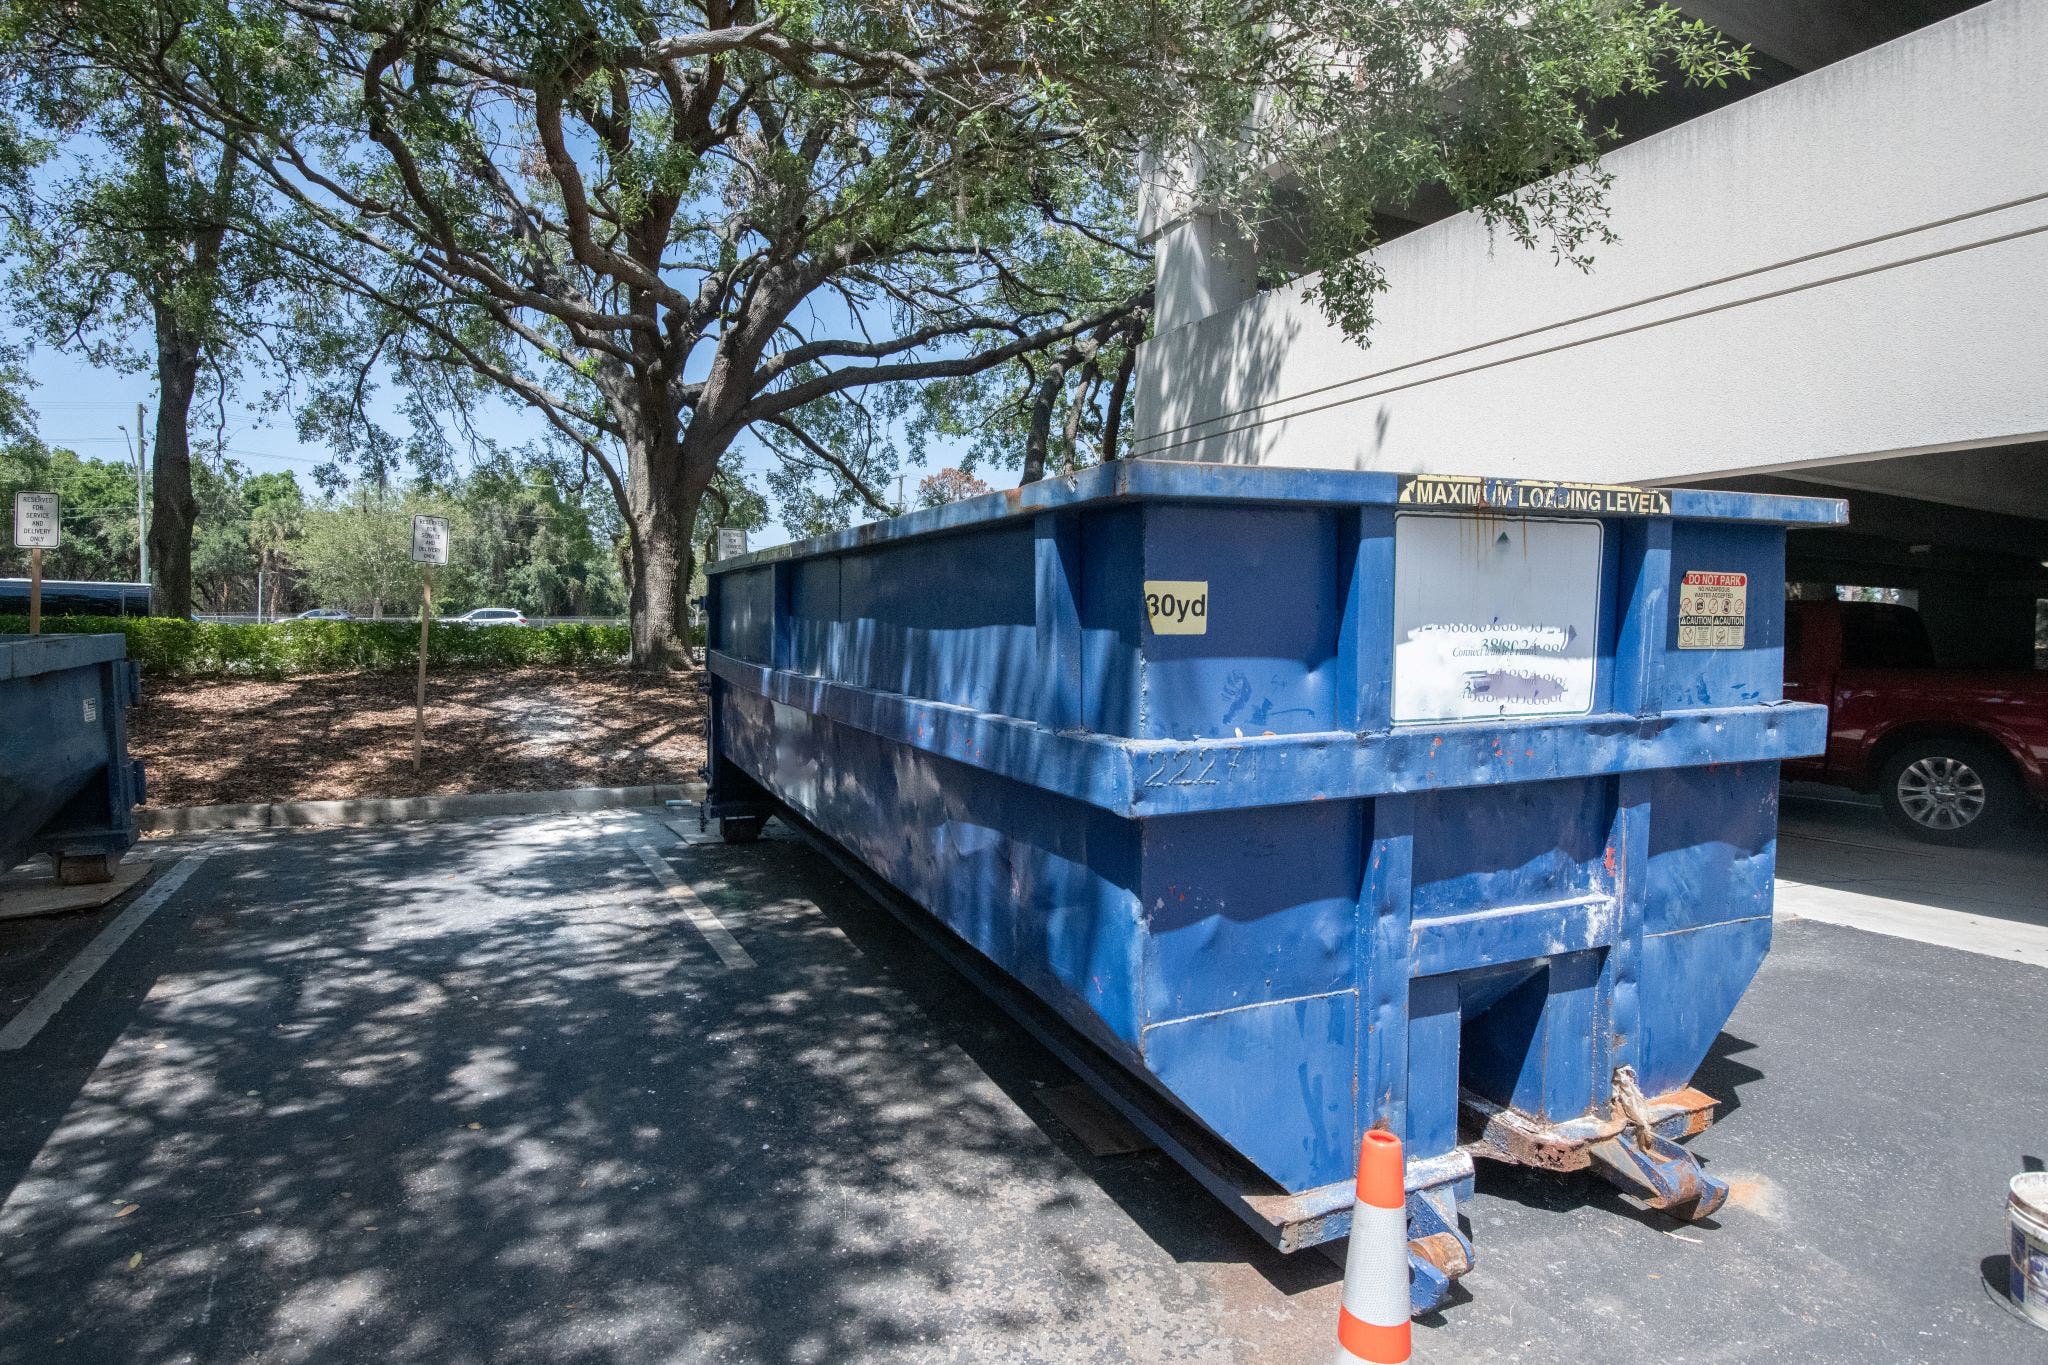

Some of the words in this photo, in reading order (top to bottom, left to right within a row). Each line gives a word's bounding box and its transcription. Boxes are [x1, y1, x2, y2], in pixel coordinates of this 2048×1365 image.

[1518, 487, 1601, 511] LOADING
[1606, 492, 1660, 514] LEVEL
[1689, 575, 1700, 584] DO
[1702, 576, 1719, 585] NOT
[1720, 576, 1741, 585] PARK
[1146, 594, 1206, 623] 30yd
[1687, 617, 1712, 625] CAUTION
[1720, 617, 1744, 625] CAUTION
